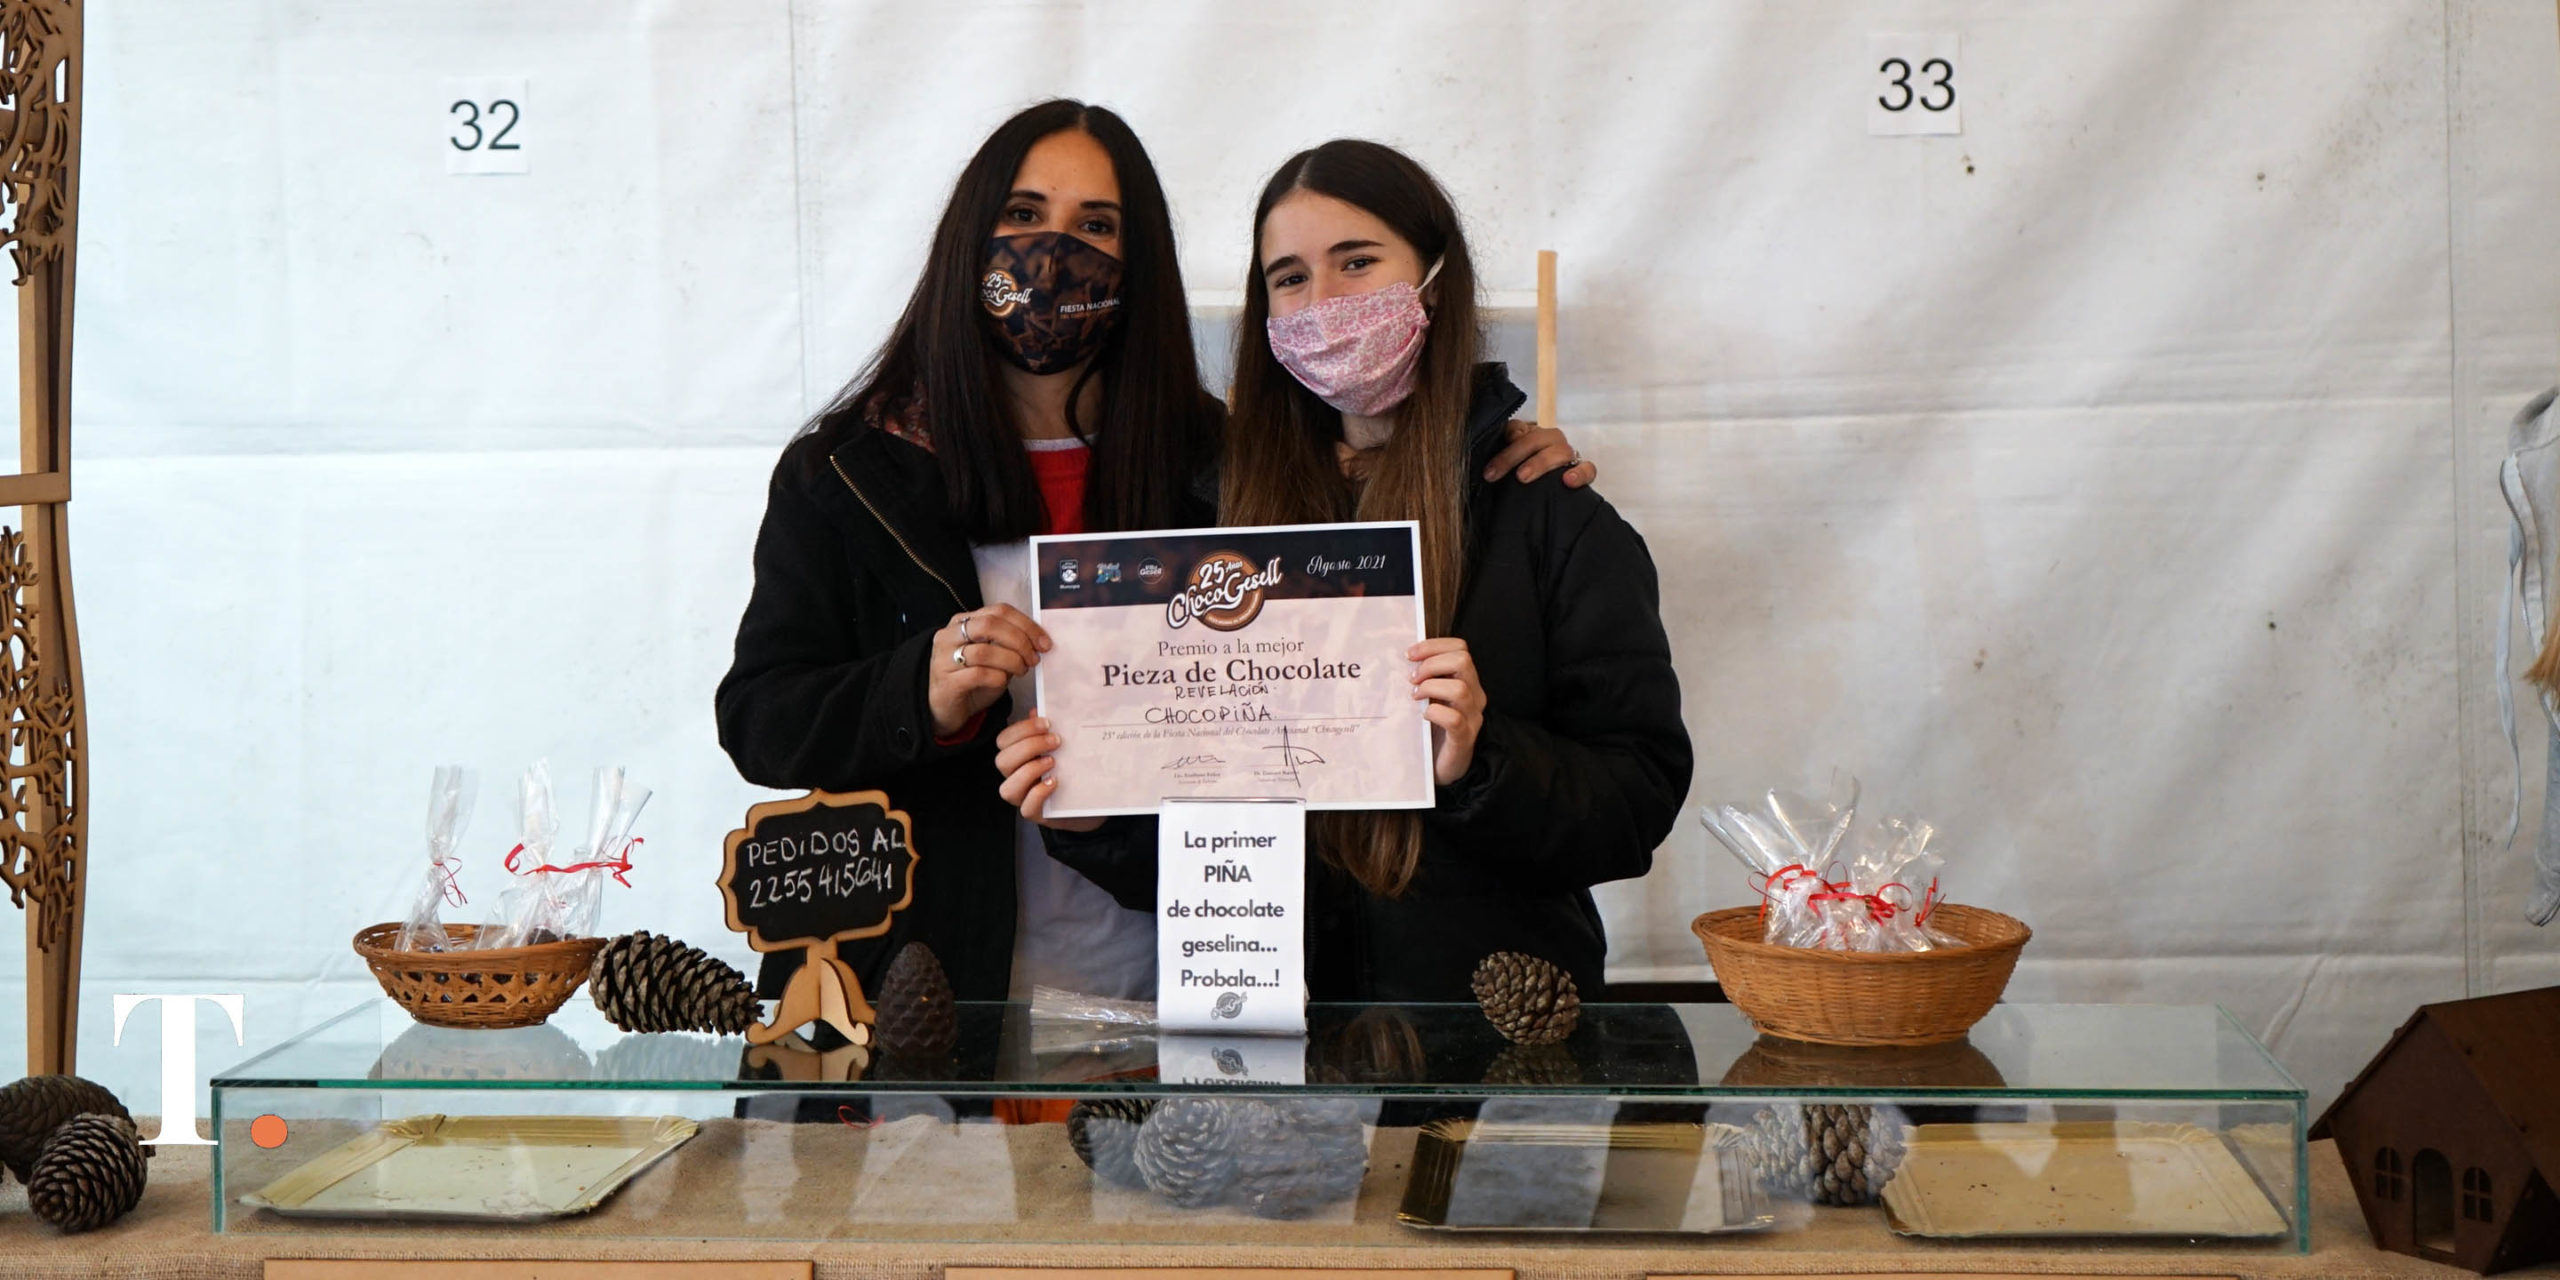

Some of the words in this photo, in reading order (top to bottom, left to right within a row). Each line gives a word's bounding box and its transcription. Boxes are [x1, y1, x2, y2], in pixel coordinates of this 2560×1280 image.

[1878, 57, 1956, 112] 33
[450, 98, 521, 152] 32
[986, 272, 1003, 289] 25
[1060, 303, 1085, 313] FIESTA
[1086, 297, 1120, 311] NACIONAL
[1199, 560, 1225, 590] 25
[1306, 554, 1351, 577] Agosto
[1355, 554, 1386, 570] 2021
[1158, 639, 1218, 657] Premio
[1223, 644, 1232, 655] a
[1236, 638, 1250, 654] la
[1256, 638, 1304, 658] mejor
[1102, 664, 1177, 687] Pieza
[1185, 661, 1217, 683] de
[1226, 657, 1361, 682] Chocolate
[872, 826, 906, 852] AL
[1184, 831, 1207, 848] La
[1211, 830, 1277, 853] primer
[1203, 859, 1252, 883] PIÑA
[750, 867, 813, 908] 2255
[1167, 899, 1191, 918] de
[1194, 899, 1285, 918] chocolate
[1182, 934, 1278, 957] geselina...
[1180, 968, 1281, 988] Probala...!
